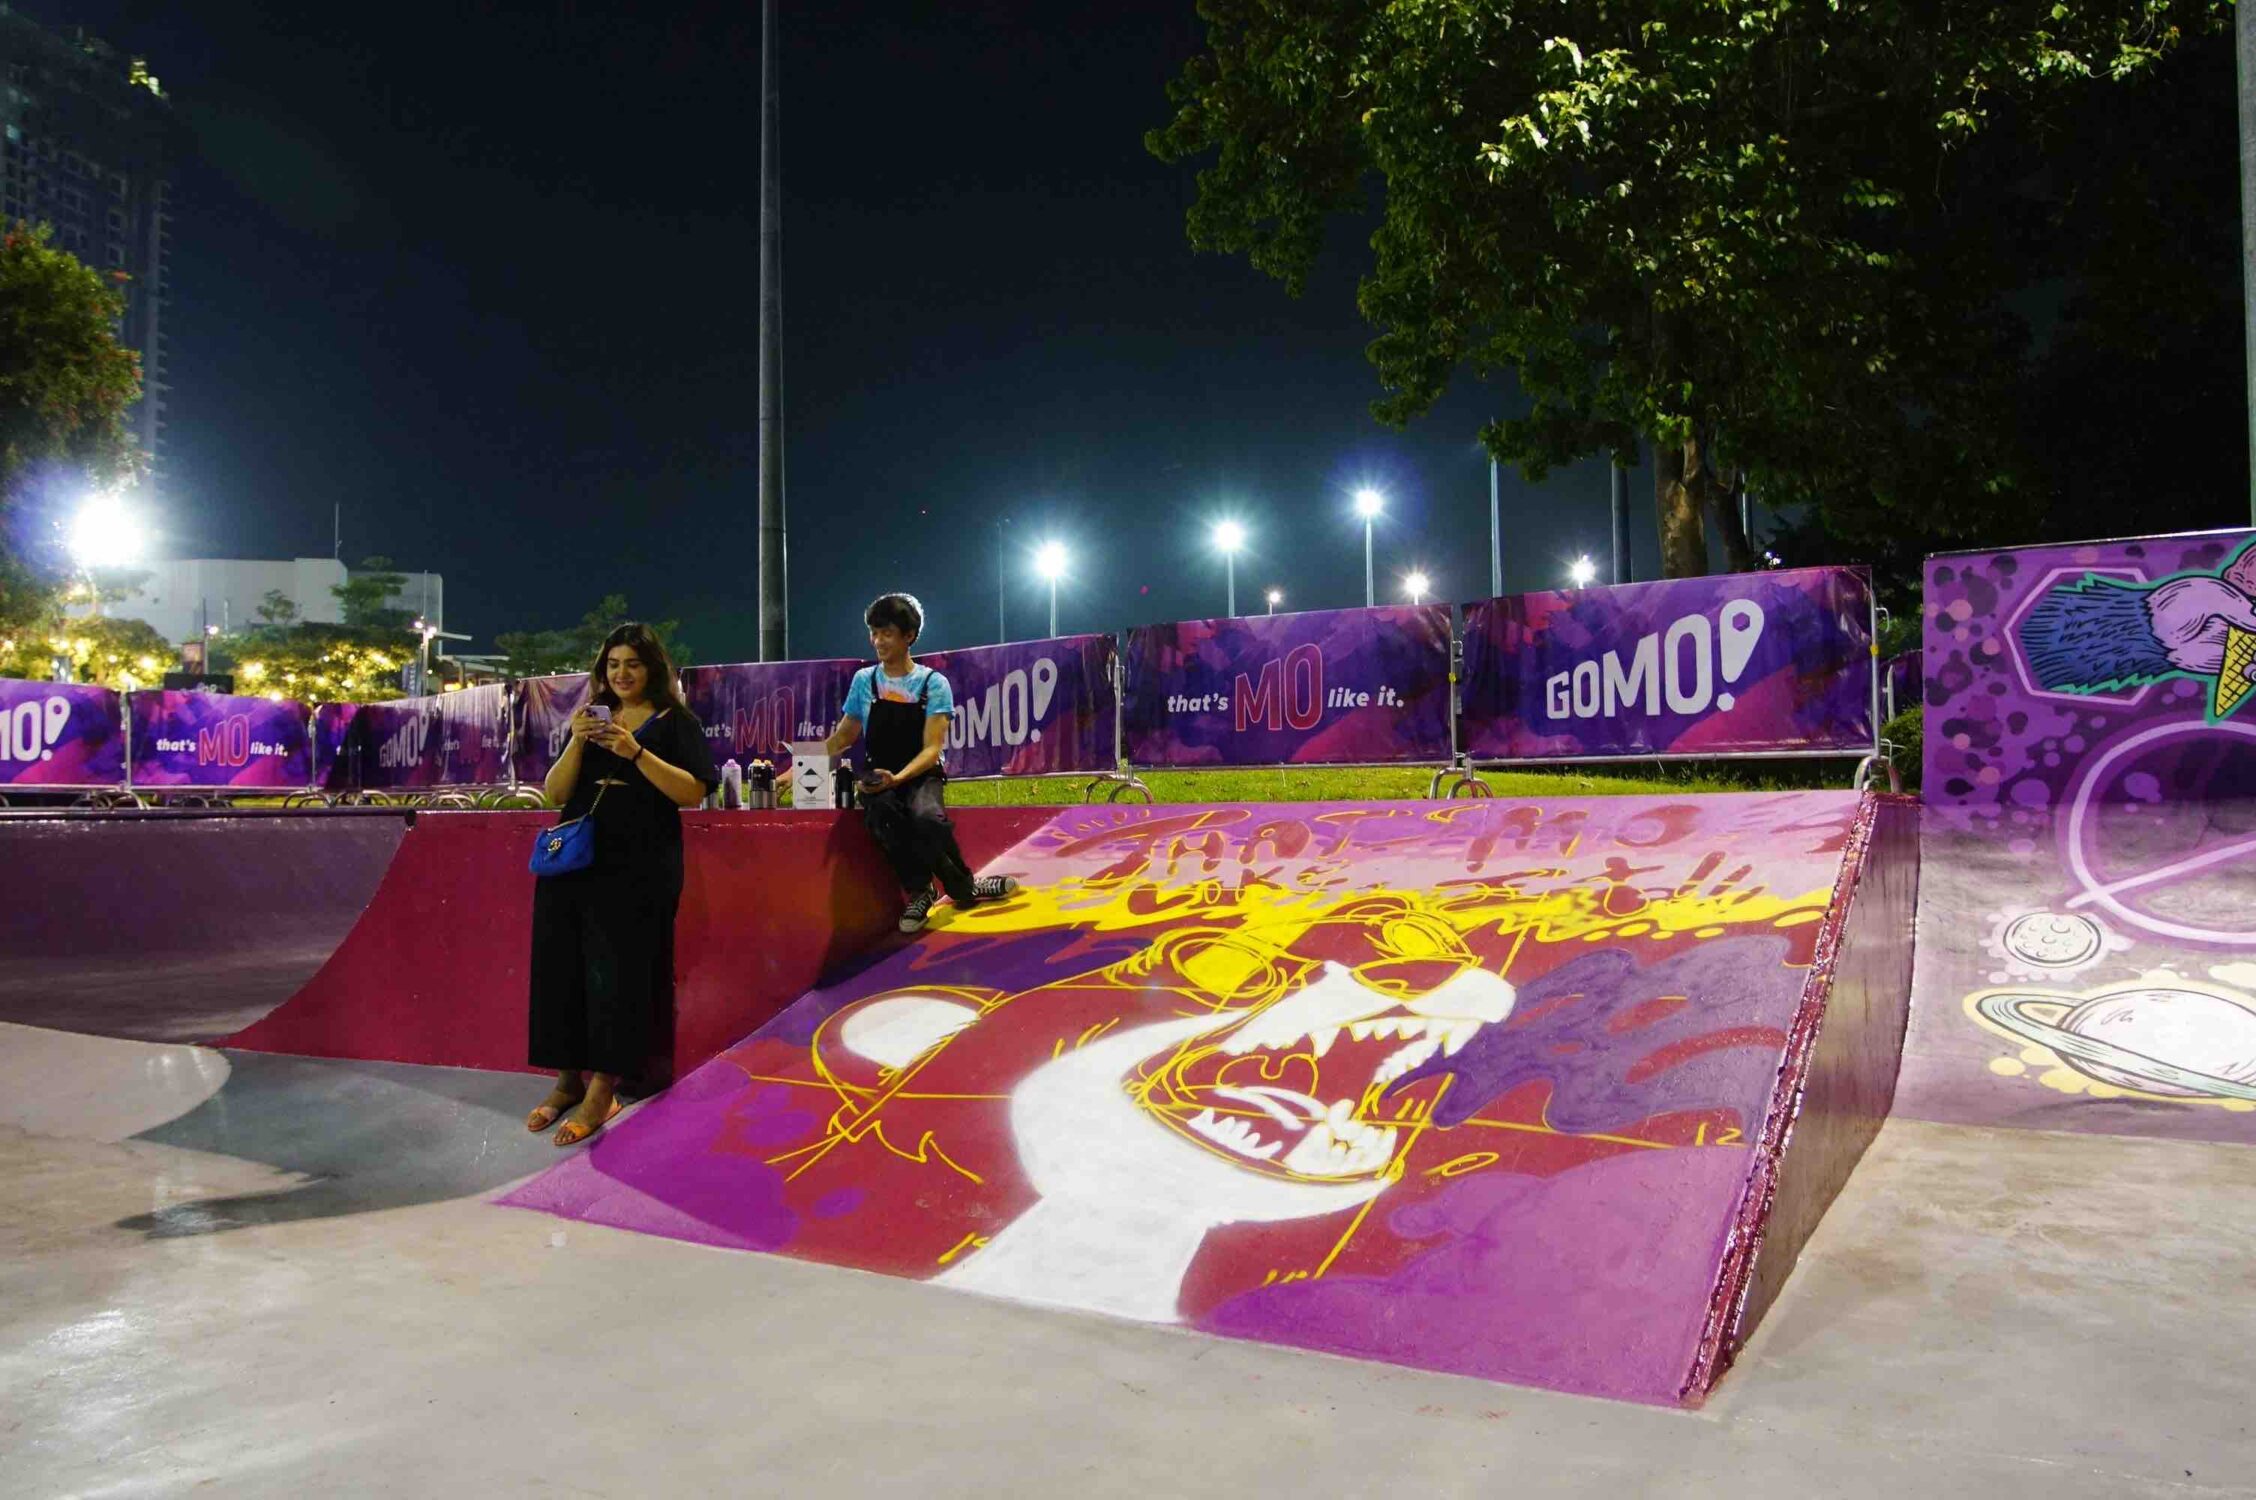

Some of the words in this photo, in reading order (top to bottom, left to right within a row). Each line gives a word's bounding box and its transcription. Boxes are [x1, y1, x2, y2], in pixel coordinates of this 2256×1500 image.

[1167, 692, 1229, 713] that's
[1235, 643, 1323, 732] MO
[1327, 687, 1368, 708] like
[1377, 686, 1405, 708] it.
[1546, 599, 1765, 719] GOMO!
[0, 696, 71, 762] O!
[702, 723, 731, 738] at's
[735, 685, 794, 754] MO
[797, 721, 825, 737] like
[942, 658, 1058, 750] OMO!
[156, 738, 196, 752] that's
[199, 713, 250, 766] MO
[250, 742, 273, 755] like
[274, 743, 289, 756] it.
[379, 709, 430, 768] GOMO!
[1695, 1121, 1748, 1146] 12
